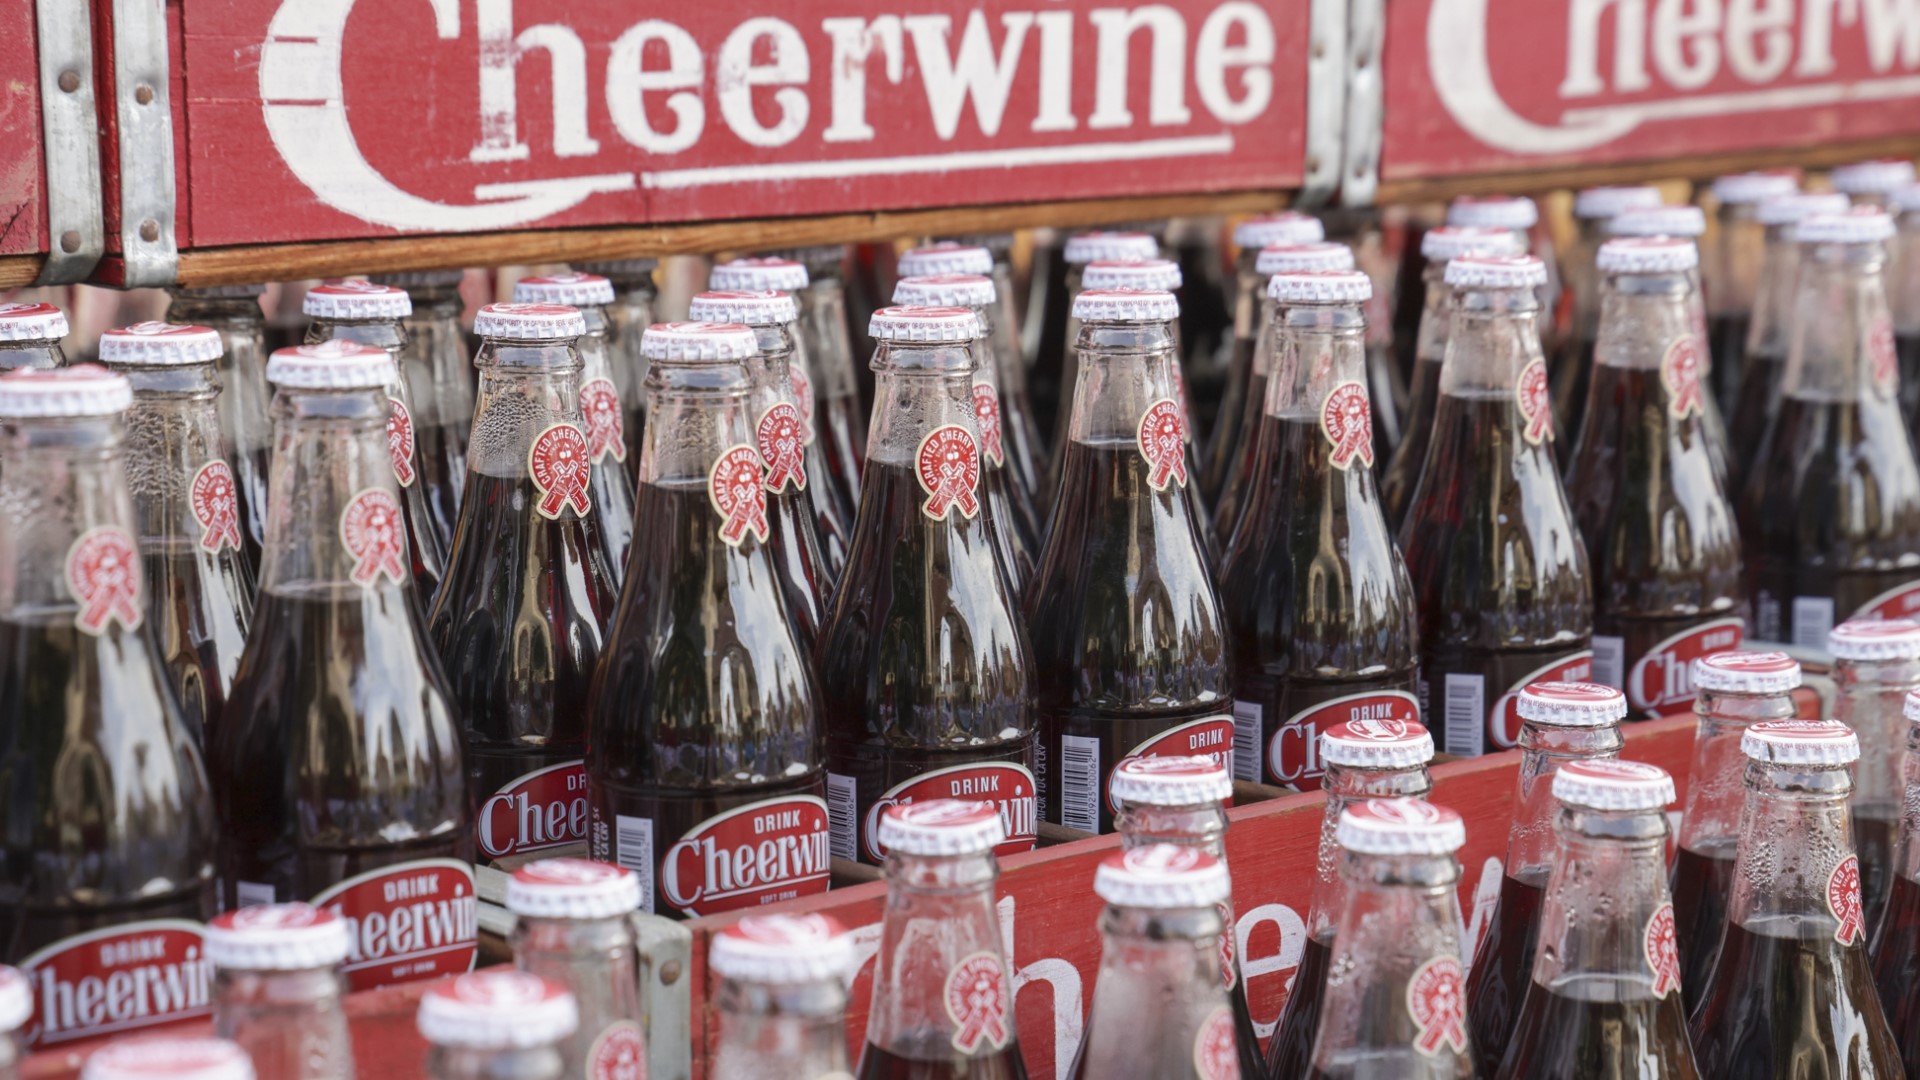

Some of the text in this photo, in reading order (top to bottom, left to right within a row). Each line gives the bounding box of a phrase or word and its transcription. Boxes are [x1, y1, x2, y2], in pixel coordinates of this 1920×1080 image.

[258, 0, 1275, 230] Cheerwine
[760, 416, 775, 461] CRAFTED
[1143, 413, 1158, 458] CRAFTED
[535, 428, 589, 485] CRAFTED CHERRY TASTE
[921, 430, 977, 486] CRAFTED CHERRY TASTE
[714, 460, 733, 510] CRAFTED
[1351, 702, 1393, 721] DRINK
[1189, 728, 1224, 750] DRINK
[951, 775, 1000, 797] DRINK
[1088, 757, 1097, 821] 70925 00062
[754, 809, 801, 834] DRINK
[847, 833, 855, 859] 0925
[383, 873, 439, 903] DRINK
[778, 890, 798, 900] DRINK
[1831, 869, 1845, 915] CRAFTED
[100, 935, 166, 967] DRINK
